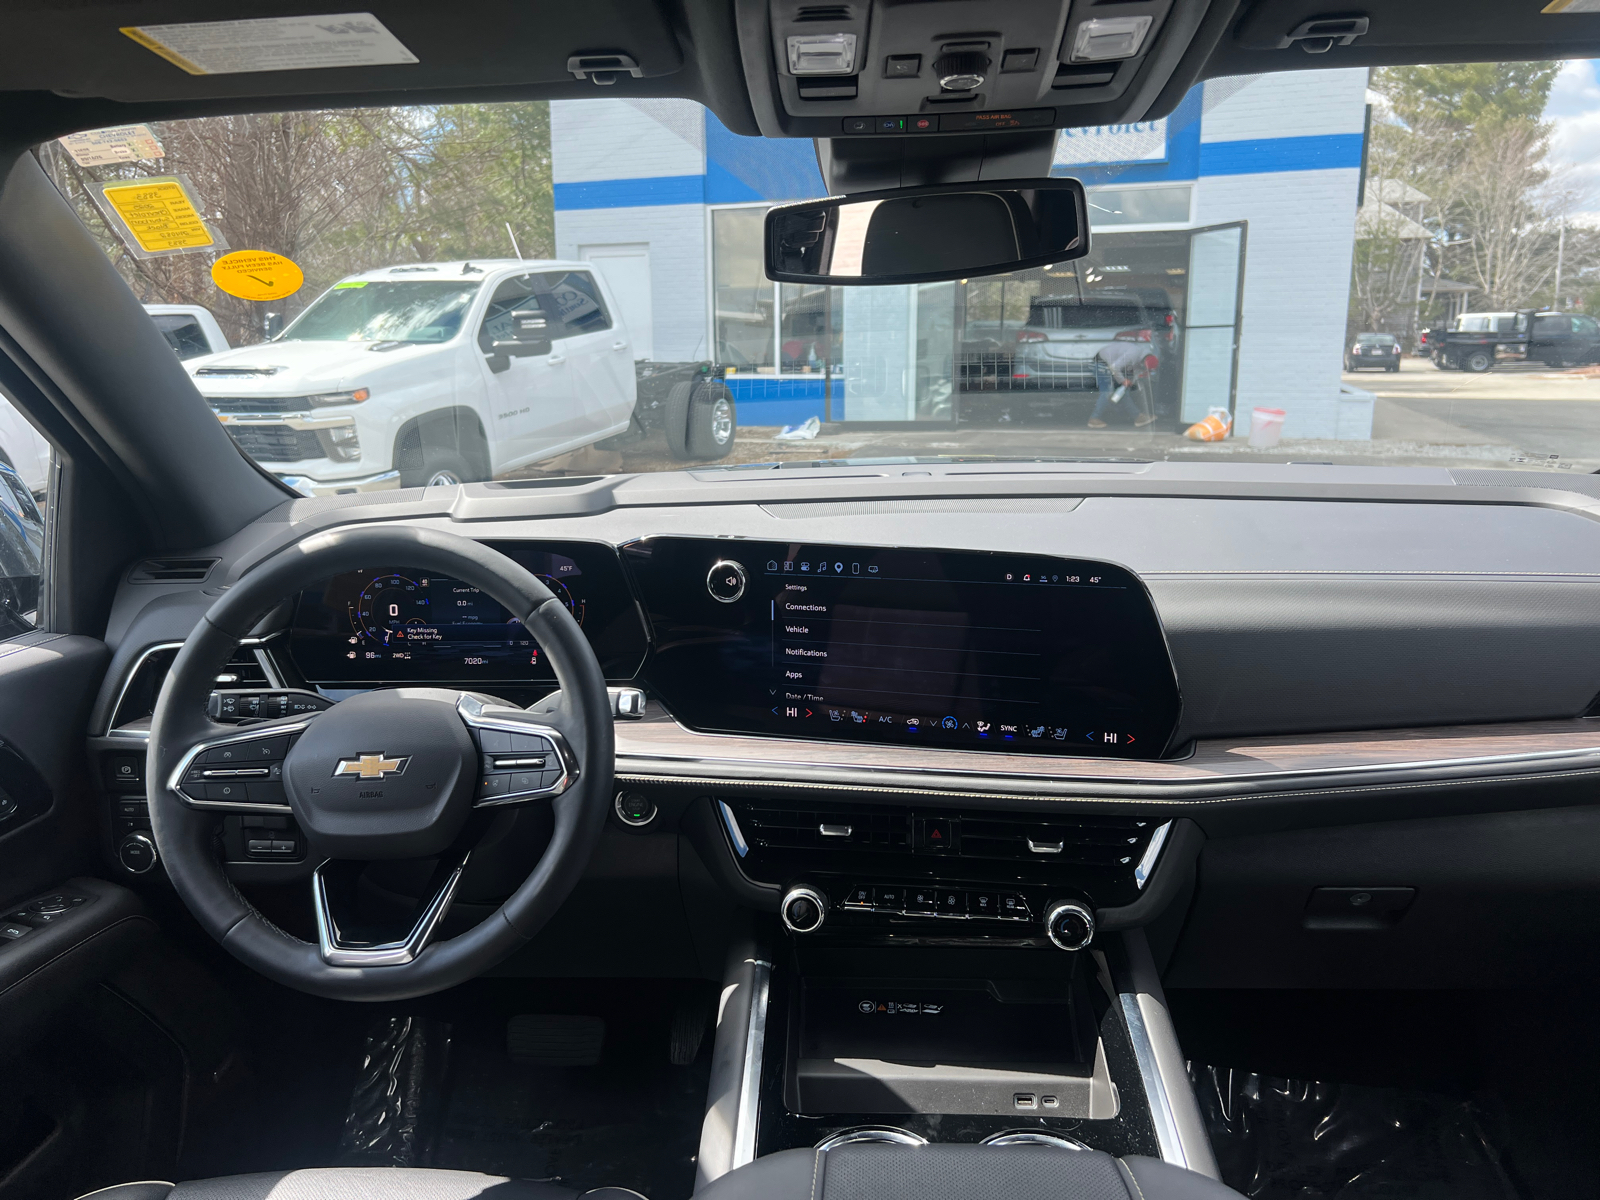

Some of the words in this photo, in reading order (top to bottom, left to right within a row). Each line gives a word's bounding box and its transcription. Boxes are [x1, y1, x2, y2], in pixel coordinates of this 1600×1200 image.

[785, 584, 807, 592] Settings
[390, 604, 398, 616] 0
[786, 603, 827, 612] Connections
[786, 648, 827, 657] Notifications
[786, 671, 802, 679] Apps
[786, 707, 797, 717] HI
[1104, 732, 1117, 743] HI
